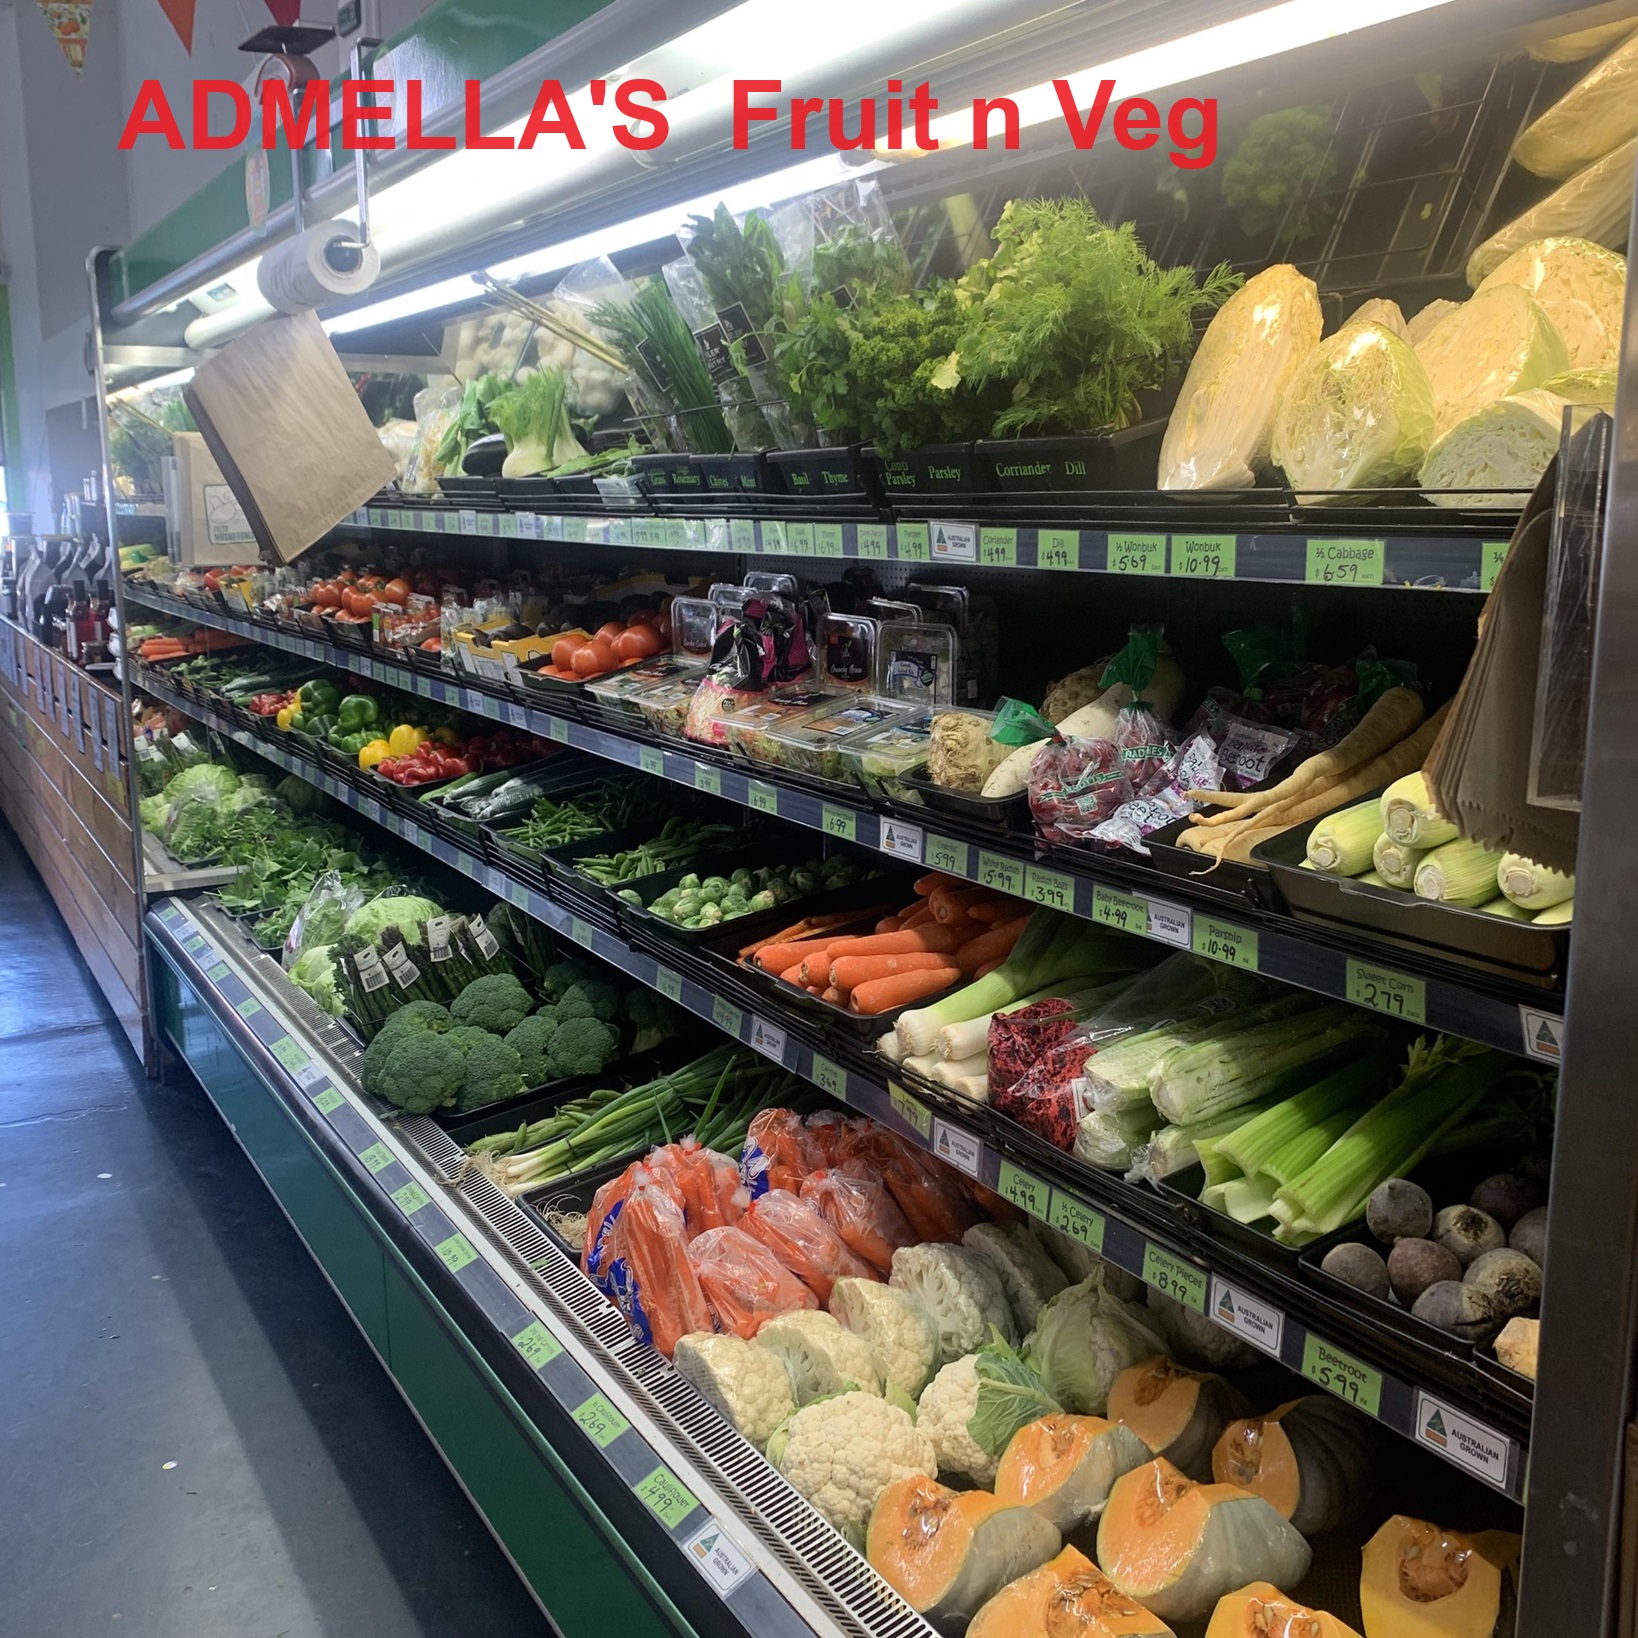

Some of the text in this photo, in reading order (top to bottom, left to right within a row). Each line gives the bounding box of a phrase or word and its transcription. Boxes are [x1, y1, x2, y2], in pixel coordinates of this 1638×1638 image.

[928, 465, 961, 482] Parsley
[995, 461, 1051, 478] Corriander
[1064, 461, 1087, 475] Dill
[791, 472, 810, 486] Basil
[821, 471, 849, 486] Thyme
[885, 472, 916, 487] Parsley
[1052, 537, 1065, 548] Dill
[1123, 540, 1158, 553] Wonbuk
[1185, 540, 1222, 553] Wonbuk
[1327, 546, 1375, 561] Cabbage
[1096, 889, 1113, 905] Baby
[1153, 913, 1186, 929] AUSTRALIAN
[1160, 922, 1180, 934] GROWN
[1208, 924, 1243, 945] Parsnip
[1356, 968, 1414, 994] Sweet Corn
[1013, 1173, 1036, 1192] Celery
[1069, 1206, 1094, 1227] Celery
[1149, 1250, 1203, 1289] Celery Pieces
[1237, 1304, 1274, 1331] AUSTRALIAN
[1243, 1316, 1266, 1335] GROWN
[1318, 1346, 1368, 1385] Beetroot
[1451, 1428, 1500, 1461] AUSTRALIAN
[1459, 1442, 1489, 1464] GROWN
[653, 1473, 690, 1508] Cauliflower
[712, 1557, 730, 1577] GROWN
[714, 1547, 741, 1576] AUSTRALIAN
